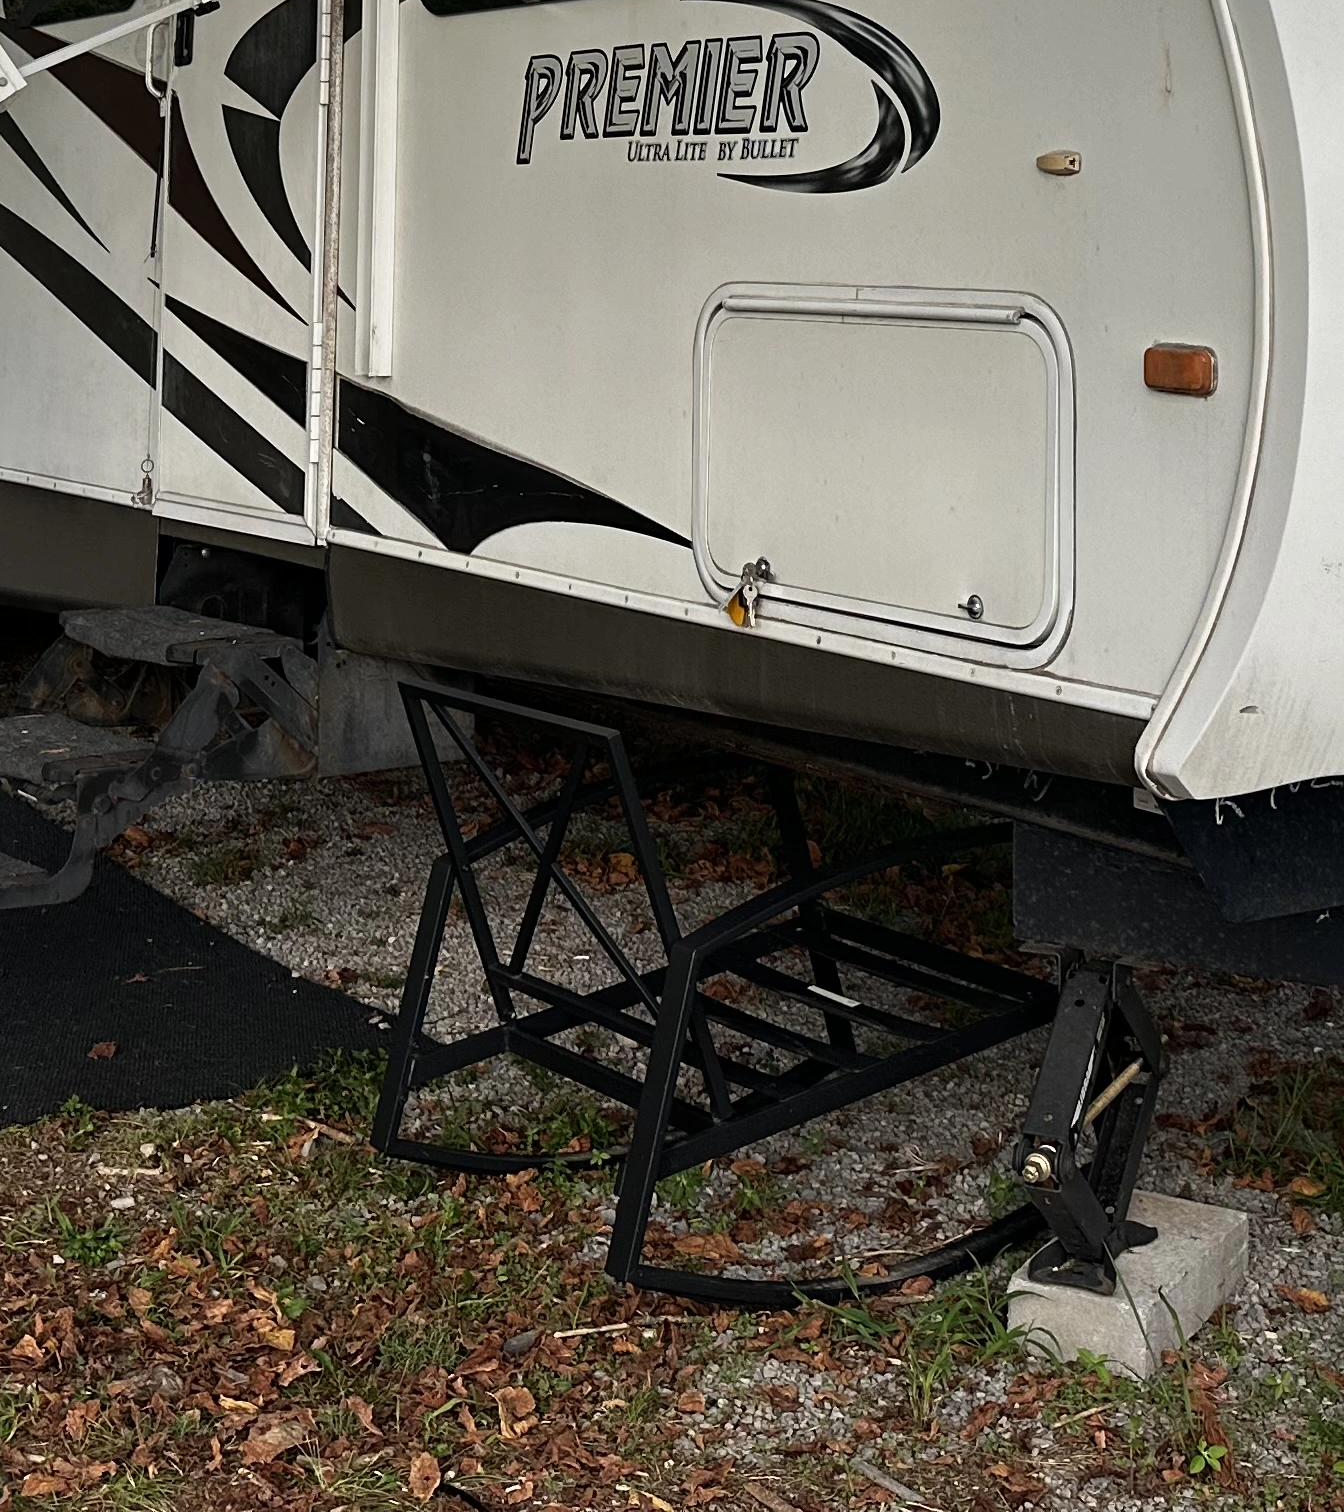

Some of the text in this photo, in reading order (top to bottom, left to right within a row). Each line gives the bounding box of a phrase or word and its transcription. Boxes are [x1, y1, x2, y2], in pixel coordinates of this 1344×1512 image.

[516, 31, 820, 165] PREMIER
[627, 140, 671, 162] ULTRA
[674, 139, 708, 162] LITE
[740, 137, 799, 160] BULLET
